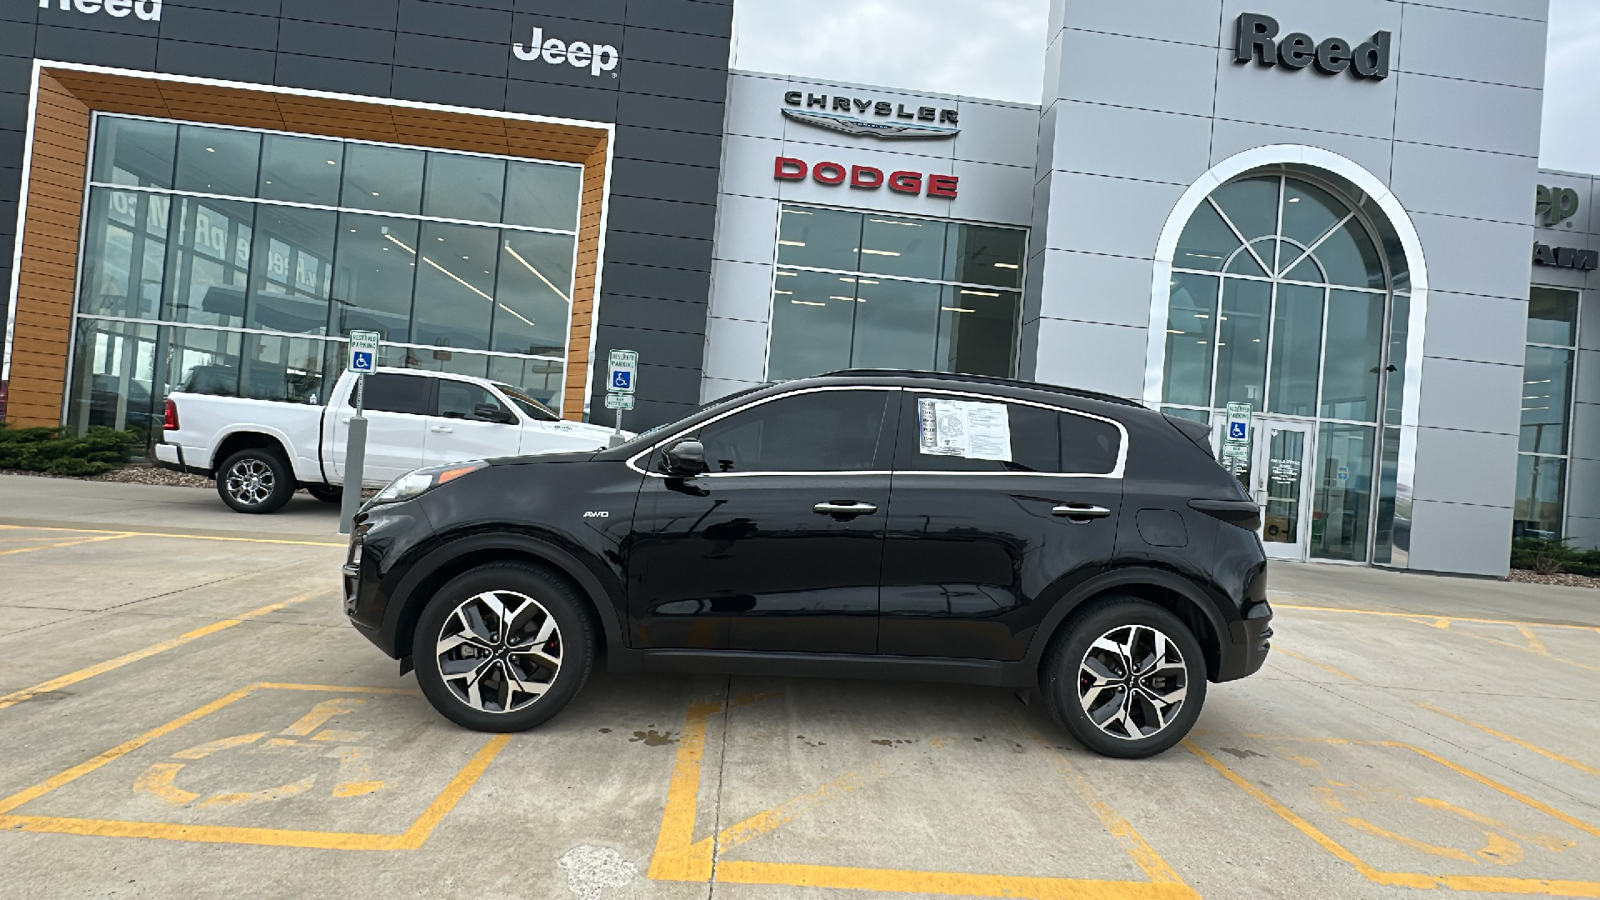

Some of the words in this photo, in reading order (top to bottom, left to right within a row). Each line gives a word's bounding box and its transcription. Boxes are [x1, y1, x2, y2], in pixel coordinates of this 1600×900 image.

[38, 0, 161, 21] eed
[513, 26, 618, 77] Jeep
[1233, 12, 1391, 81] Reed
[784, 90, 960, 123] CHRYSLER
[773, 156, 960, 199] DODGE
[1532, 241, 1599, 271] AM
